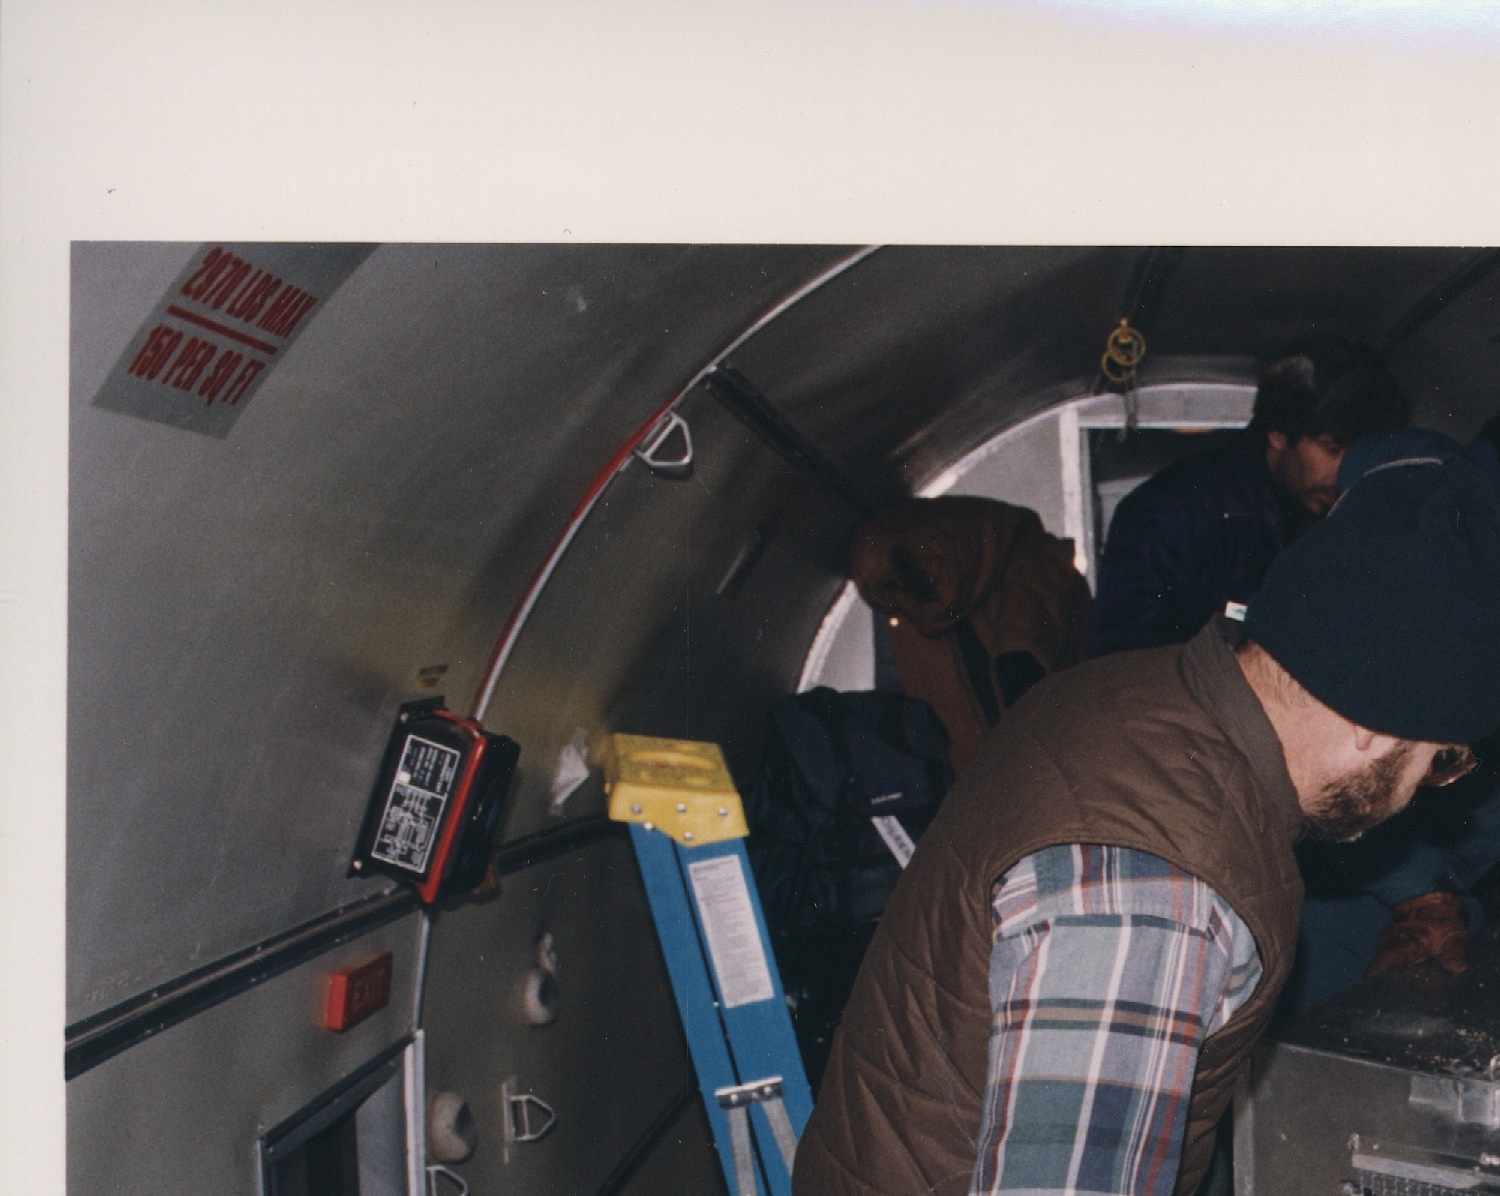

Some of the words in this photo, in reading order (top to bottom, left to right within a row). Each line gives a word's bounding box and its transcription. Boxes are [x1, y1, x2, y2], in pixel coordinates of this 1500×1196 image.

[225, 268, 282, 323] LBS
[256, 285, 318, 339] MAX
[127, 323, 184, 381] 150
[162, 336, 217, 392] PER
[197, 350, 244, 406] SQ
[222, 358, 267, 405] FT
